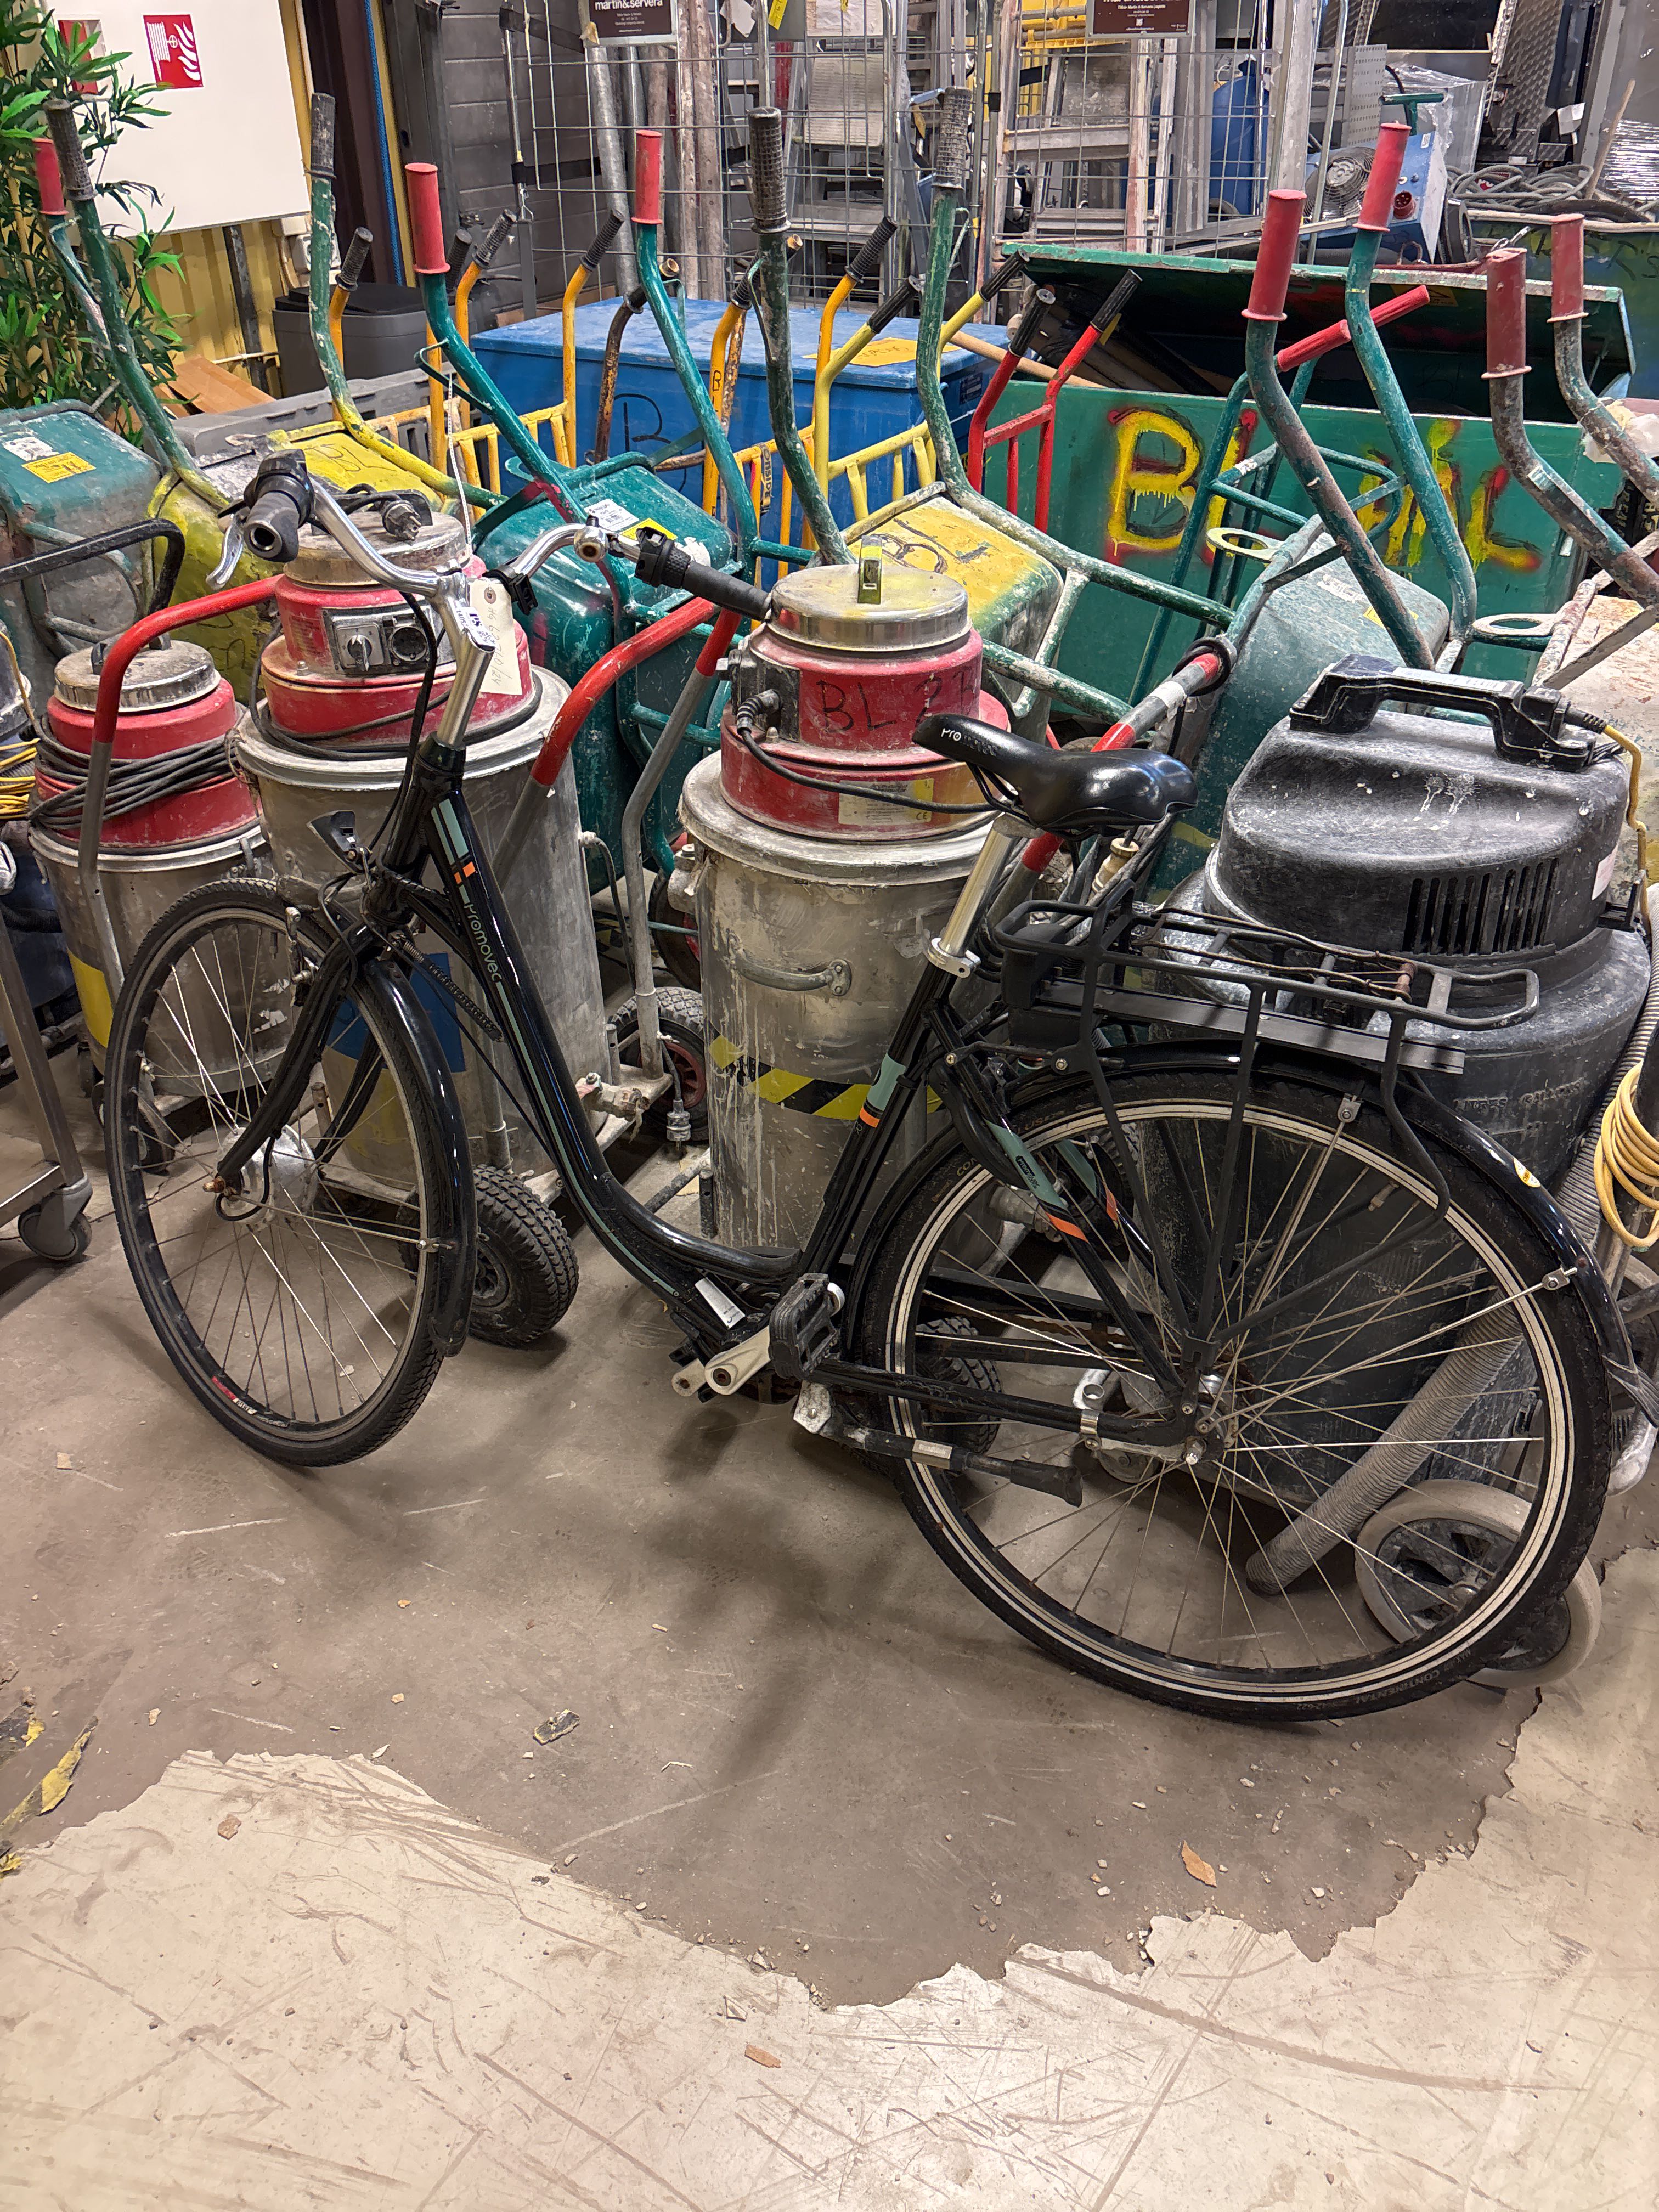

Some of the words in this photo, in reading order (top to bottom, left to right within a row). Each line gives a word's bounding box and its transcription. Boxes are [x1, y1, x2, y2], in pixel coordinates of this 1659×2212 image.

[816, 680, 896, 733] BL
[463, 904, 503, 983] Promovec
[1355, 1669, 1441, 1703] CONTINENTAL
